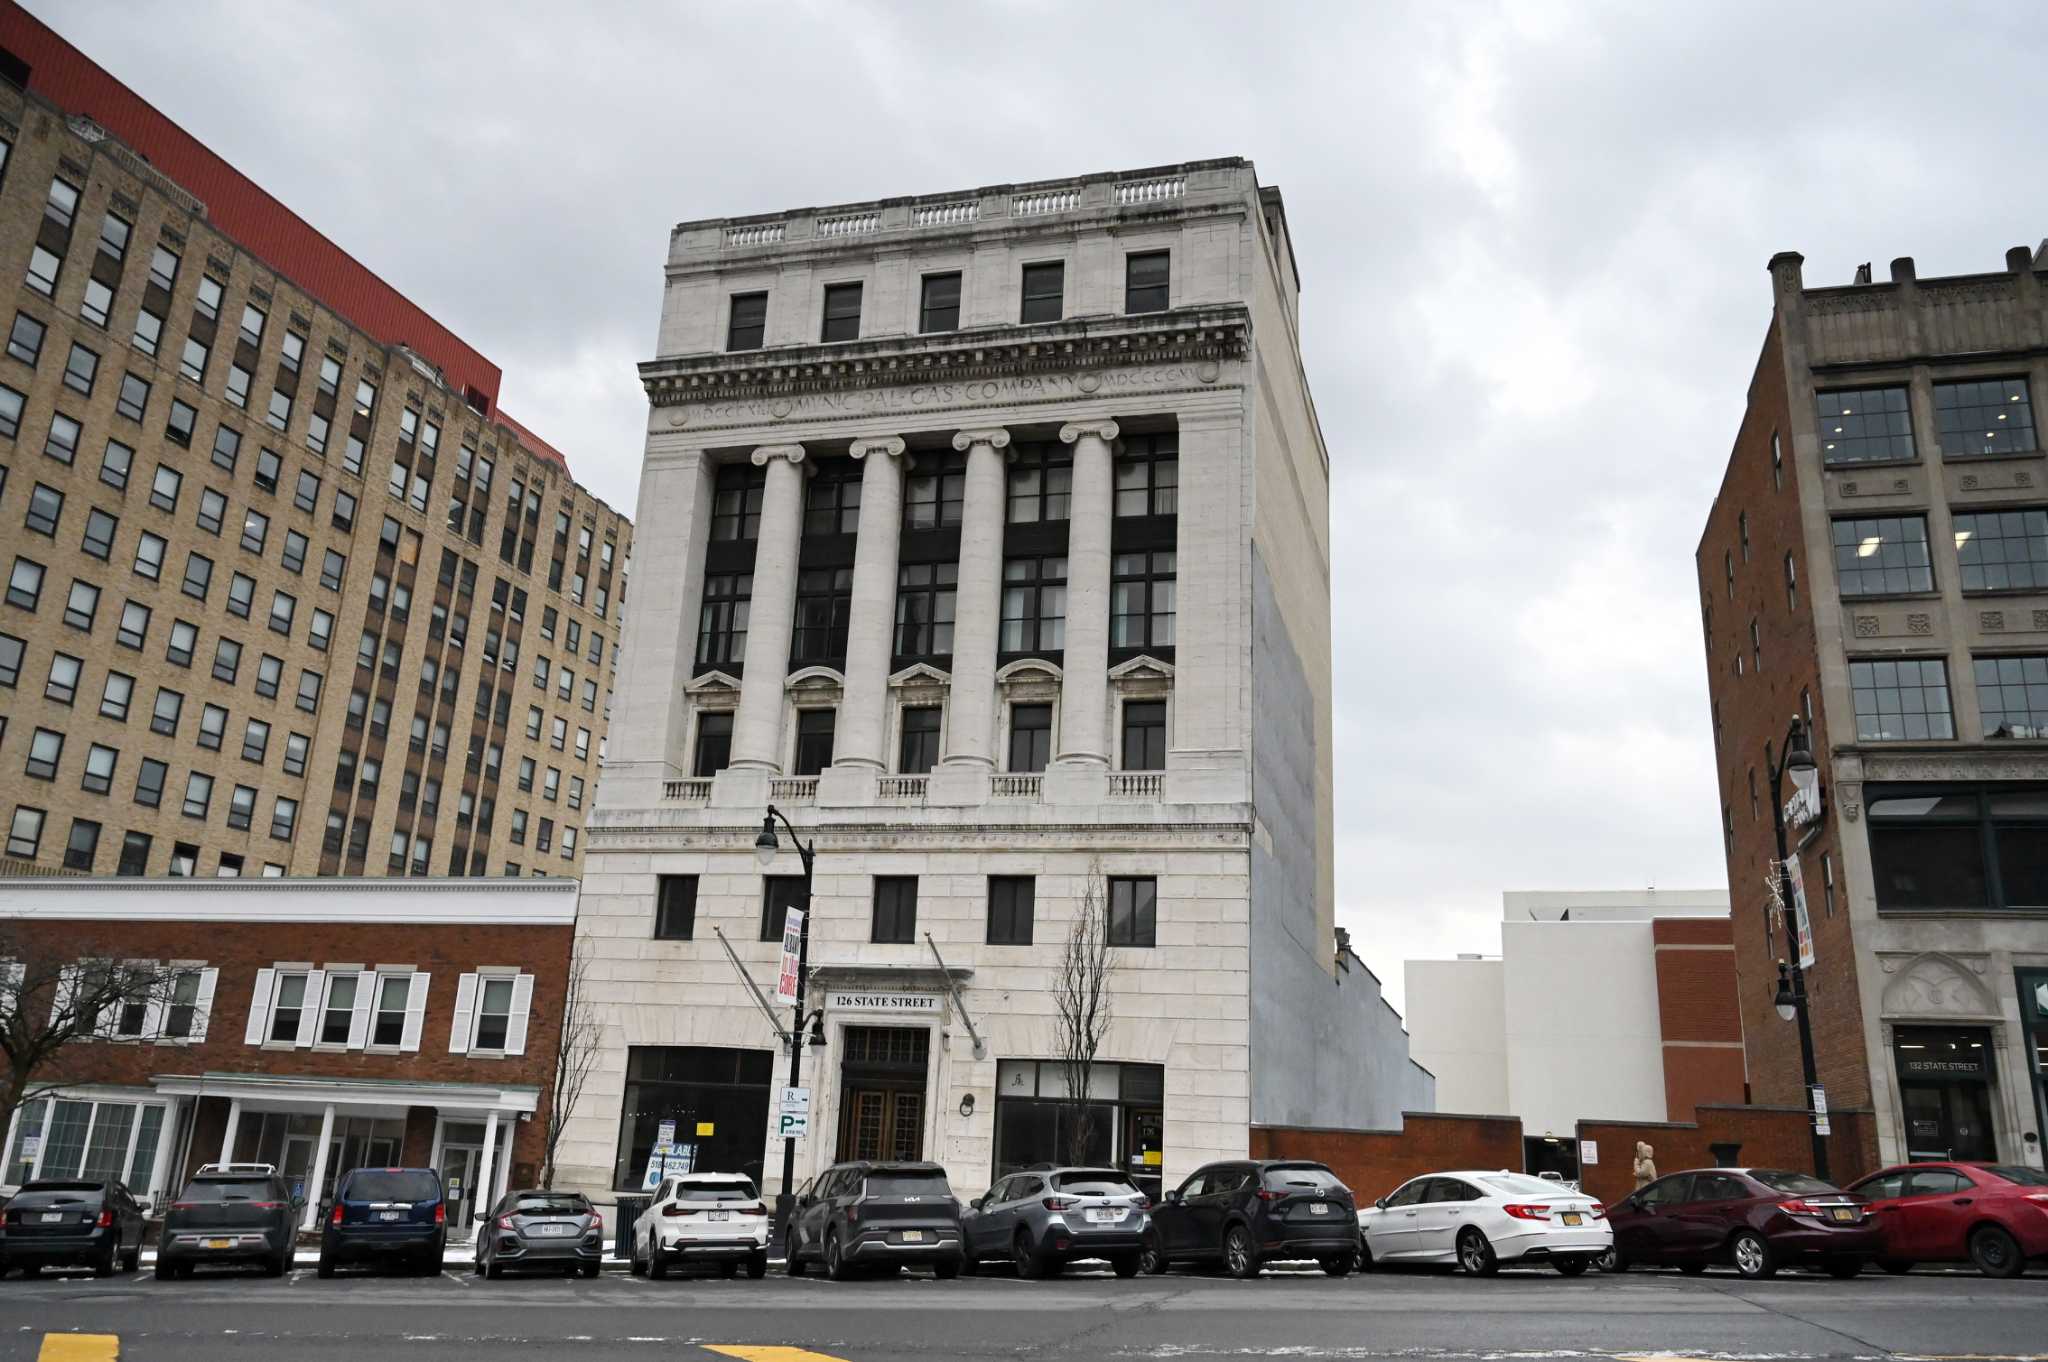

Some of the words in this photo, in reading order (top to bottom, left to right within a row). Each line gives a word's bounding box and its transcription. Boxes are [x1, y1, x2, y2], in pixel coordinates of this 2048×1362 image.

[911, 386, 953, 405] GAS
[966, 374, 1077, 401] COMPANY
[779, 973, 797, 997] CORE
[837, 996, 852, 1006] 126
[854, 997, 888, 1007] STATE
[891, 997, 934, 1008] STREET
[1923, 1062, 1947, 1071] STATE
[1948, 1063, 1977, 1071] STREET
[780, 1115, 795, 1134] P
